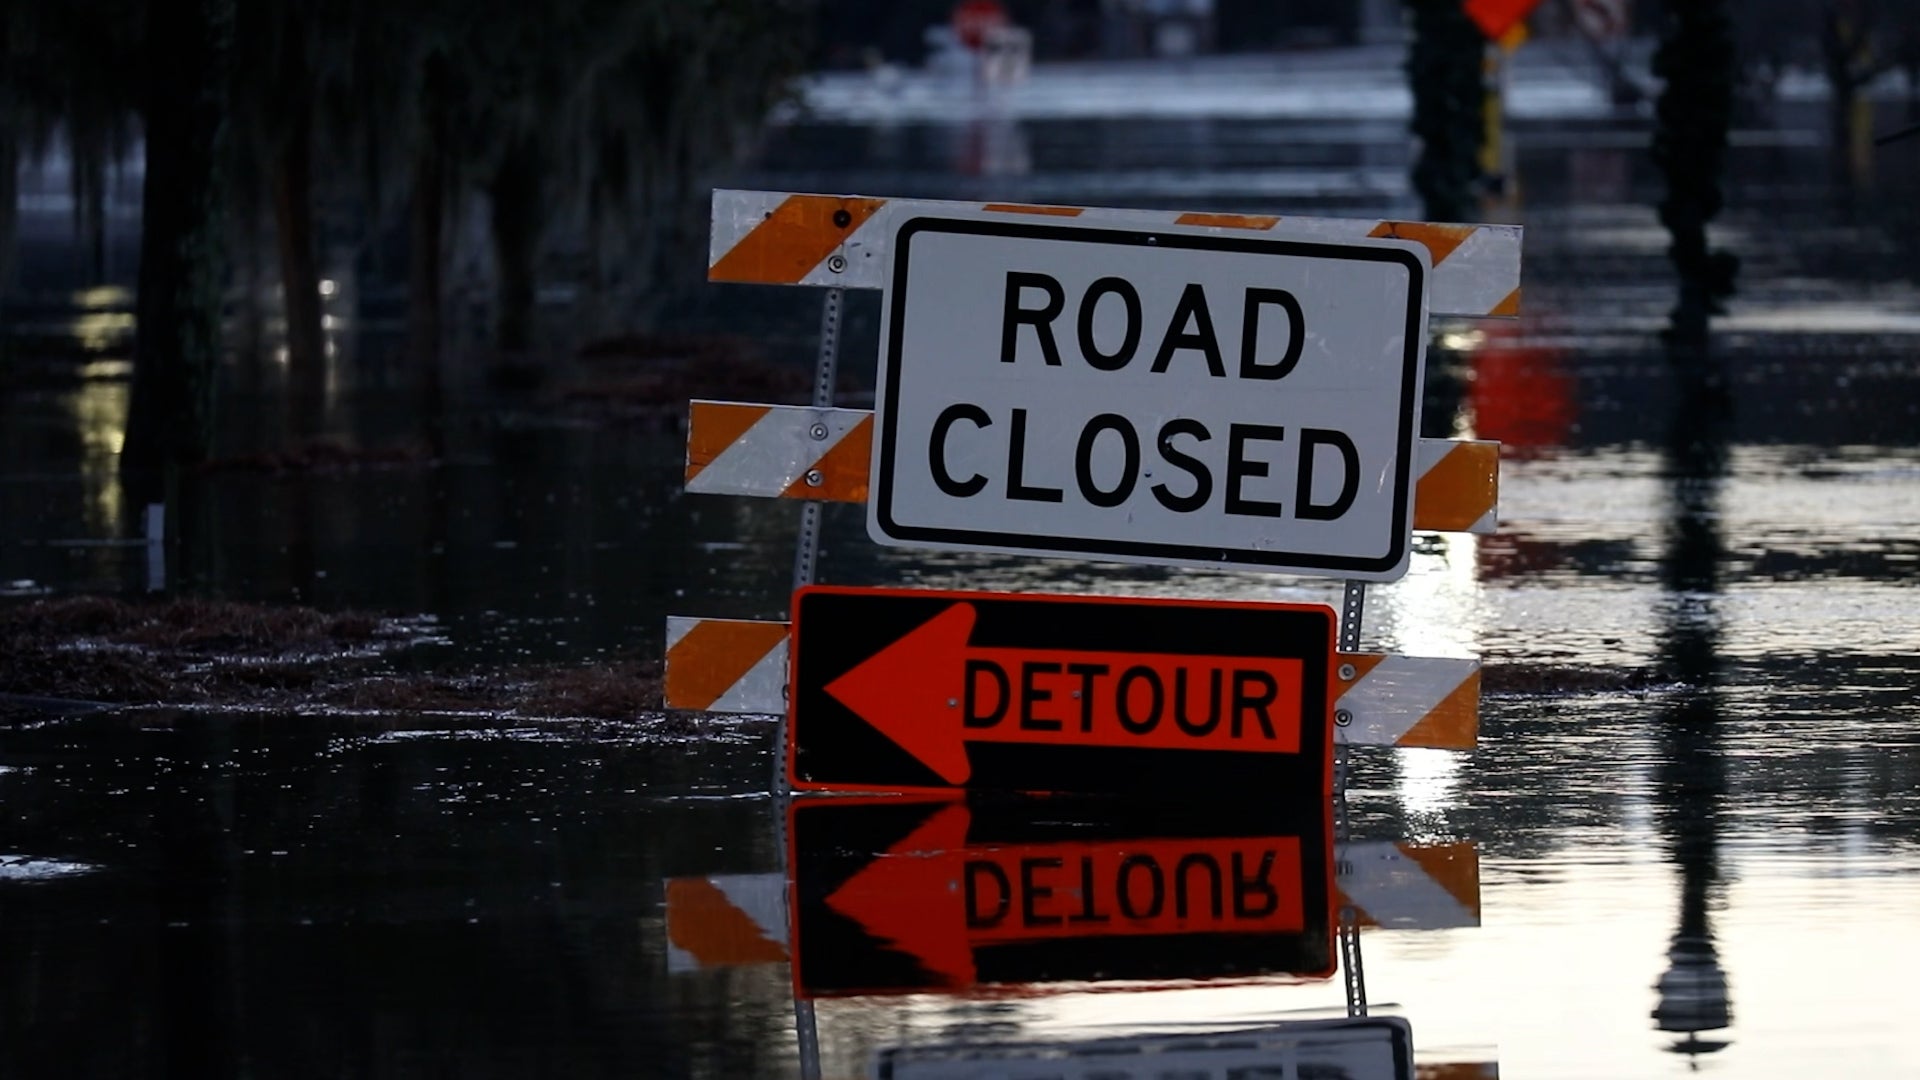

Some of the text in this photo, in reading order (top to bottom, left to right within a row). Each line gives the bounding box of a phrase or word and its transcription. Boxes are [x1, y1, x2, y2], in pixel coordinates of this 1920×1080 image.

[1000, 270, 1305, 381] ROAD
[929, 403, 1361, 521] CLOSED
[963, 660, 1279, 740] DETOUR
